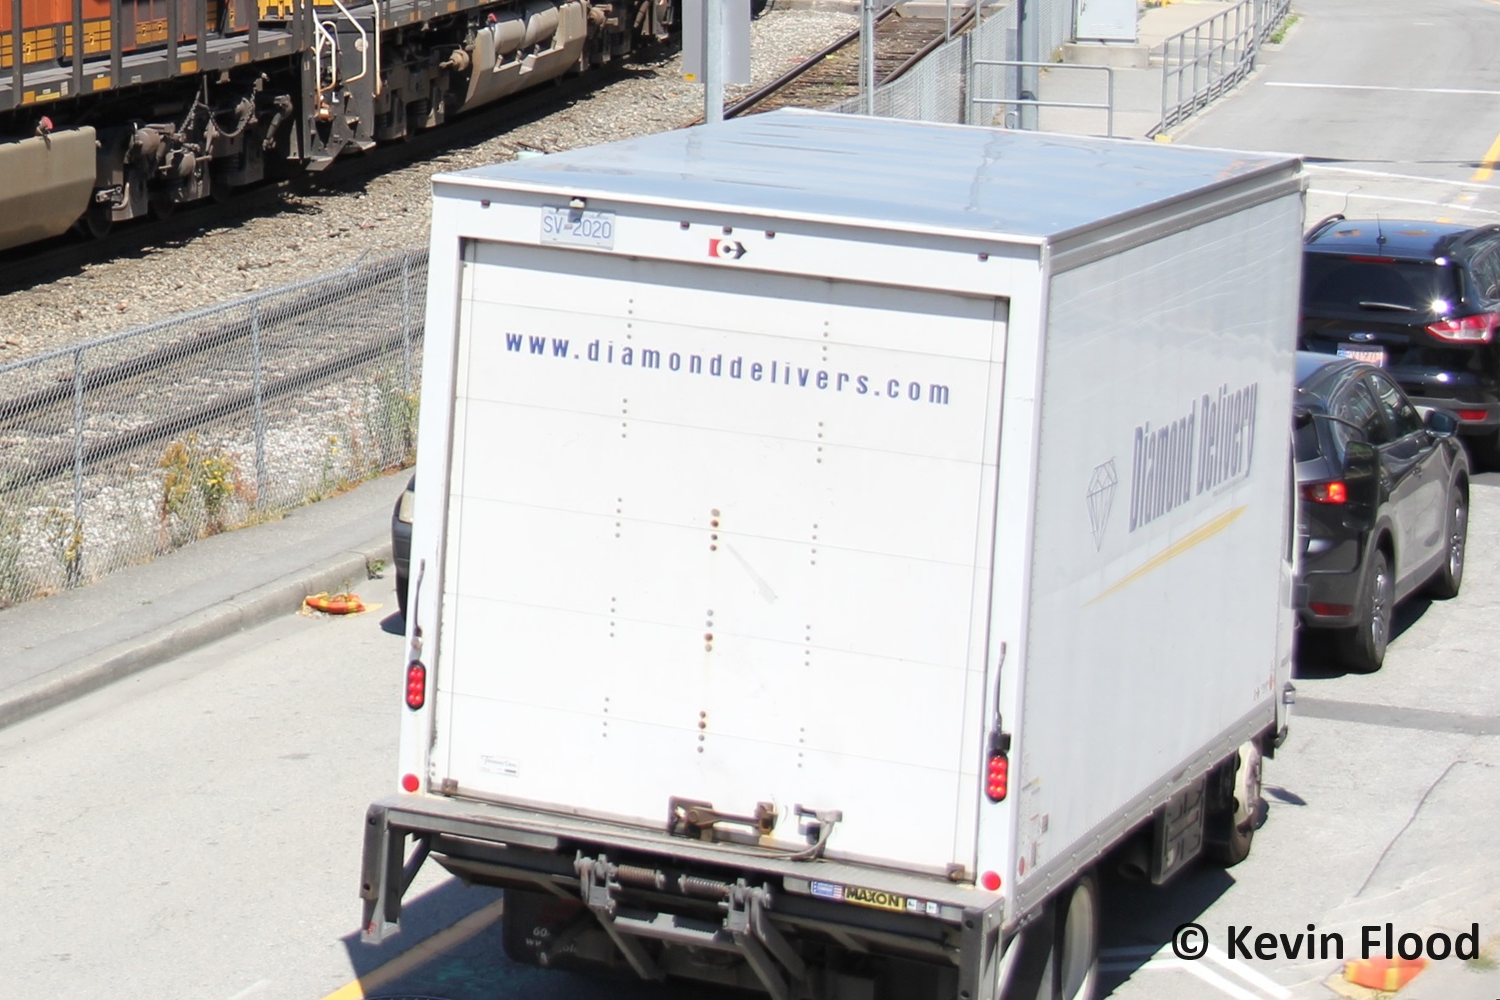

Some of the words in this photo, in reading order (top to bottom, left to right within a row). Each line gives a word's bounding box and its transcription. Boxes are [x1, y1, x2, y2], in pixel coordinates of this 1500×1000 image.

[505, 332, 951, 405] www.diamonddelivers.com
[1129, 399, 1196, 533] Diamond
[1195, 382, 1258, 497] Delivery
[845, 886, 900, 908] MAXON
